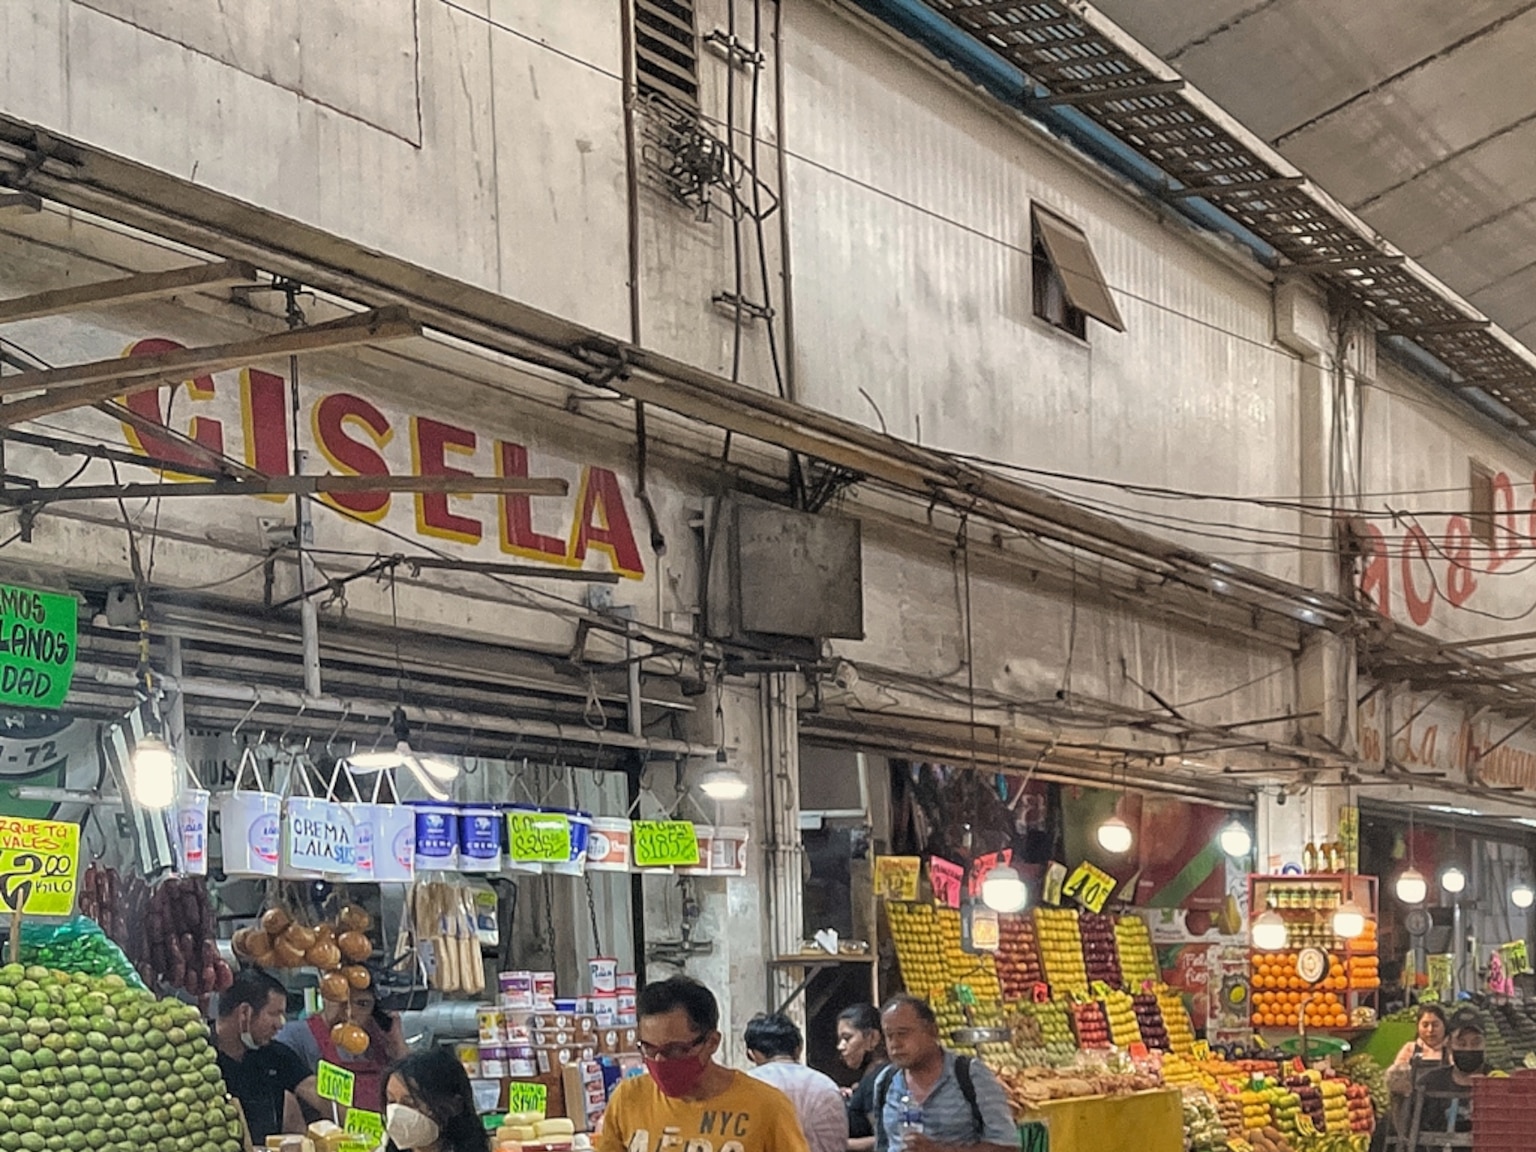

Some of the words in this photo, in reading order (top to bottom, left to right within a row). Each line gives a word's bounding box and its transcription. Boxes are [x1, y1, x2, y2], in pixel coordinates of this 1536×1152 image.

[121, 338, 644, 579] GISELA
[3, 666, 50, 698] DAD
[3, 836, 61, 850] VALES
[293, 818, 349, 843] CREMA
[36, 880, 73, 893] KILO
[700, 1110, 749, 1136] NYC
